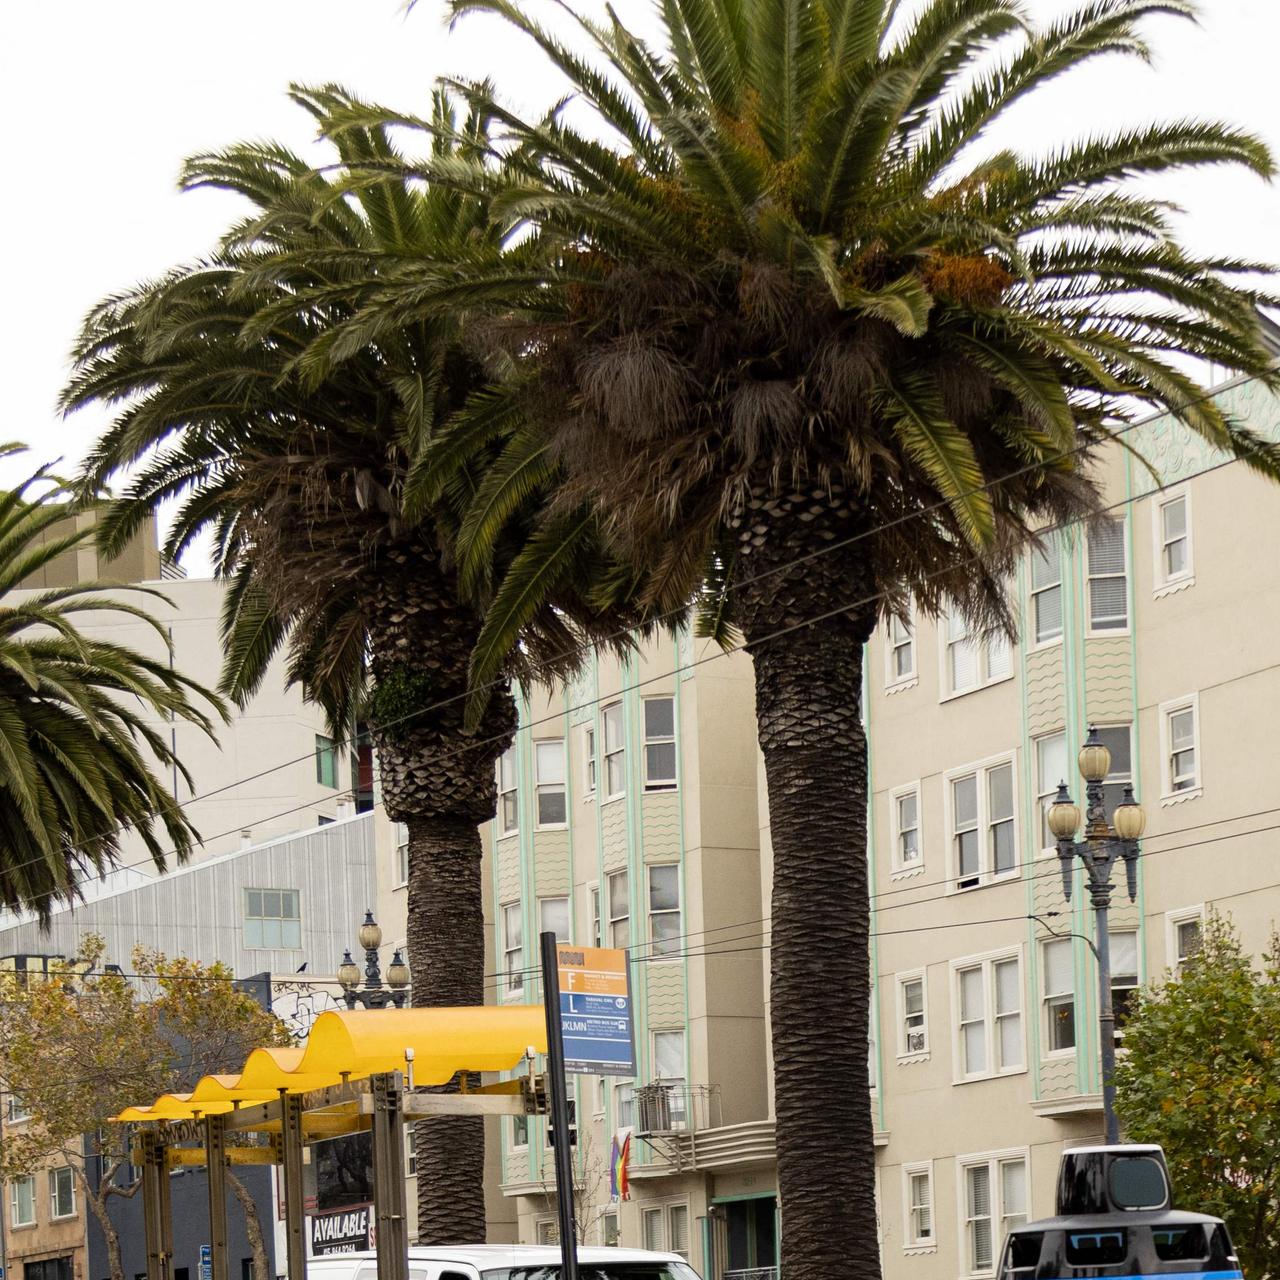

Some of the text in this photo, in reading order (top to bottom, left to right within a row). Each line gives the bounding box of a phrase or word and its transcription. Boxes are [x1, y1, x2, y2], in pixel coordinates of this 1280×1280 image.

[567, 972, 576, 990] F
[569, 995, 578, 1013] L
[314, 1211, 366, 1242] AVAILABLE
